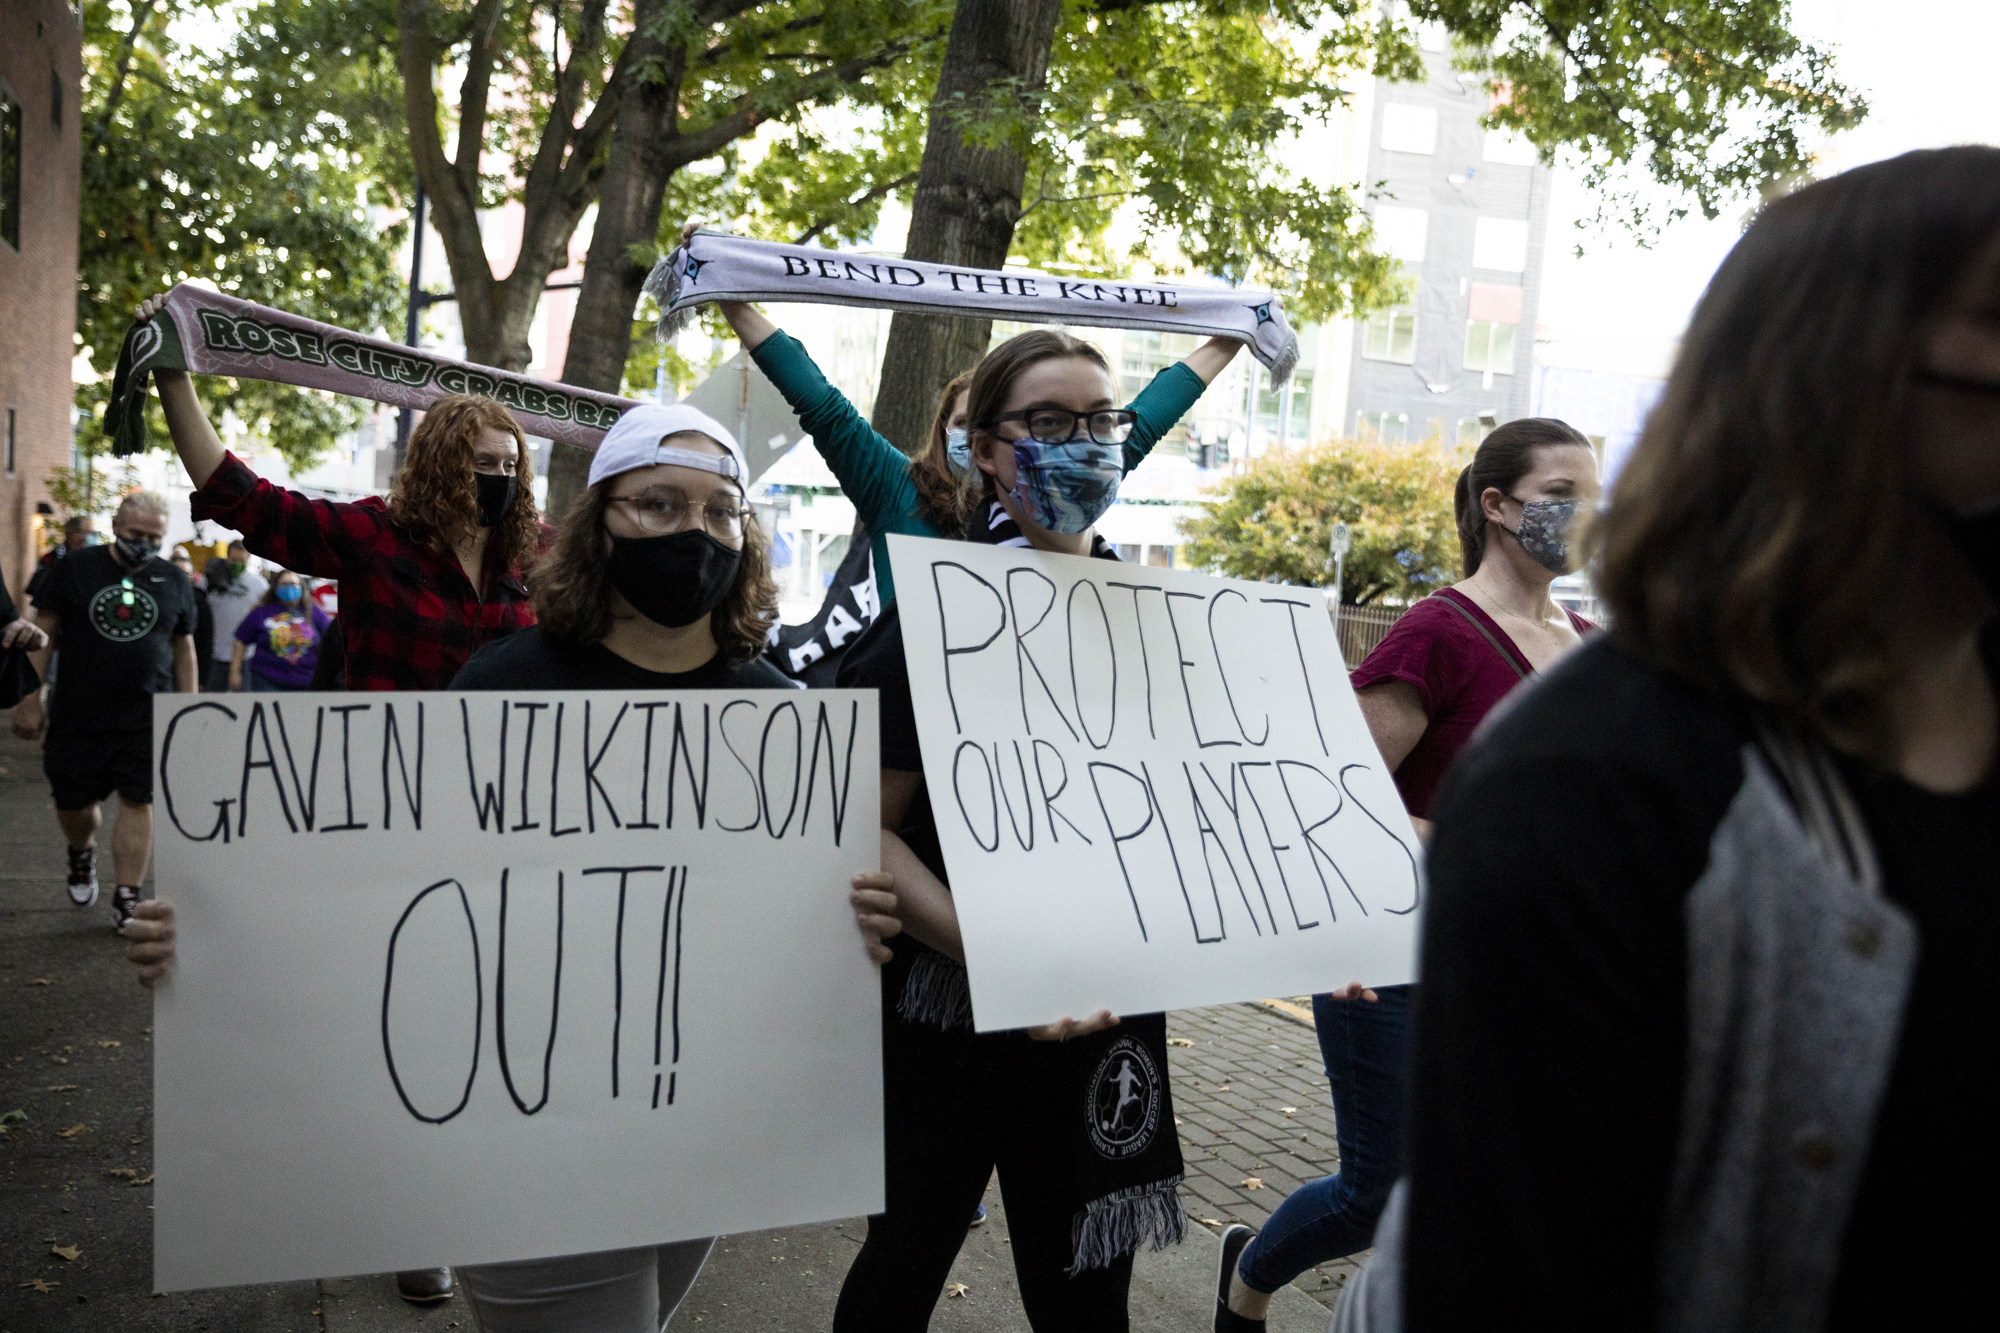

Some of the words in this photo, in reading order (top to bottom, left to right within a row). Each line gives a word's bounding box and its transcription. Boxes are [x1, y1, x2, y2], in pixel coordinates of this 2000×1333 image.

[779, 254, 925, 288] BEND
[937, 269, 1040, 298] THE
[1055, 280, 1178, 308] KNEE
[199, 309, 327, 366] ROSE
[328, 340, 435, 387] CITY
[437, 367, 571, 419] GRABS
[930, 560, 1329, 758] PROTECT
[160, 701, 424, 844] GAVIN
[460, 698, 859, 848] WILKINSON
[952, 739, 1093, 853] OUR
[1087, 760, 1421, 944] PLAYERS
[381, 864, 688, 1125] OUT!!
[1120, 1130, 1150, 1156] LEAGUE
[1147, 1089, 1160, 1131] SOCCER
